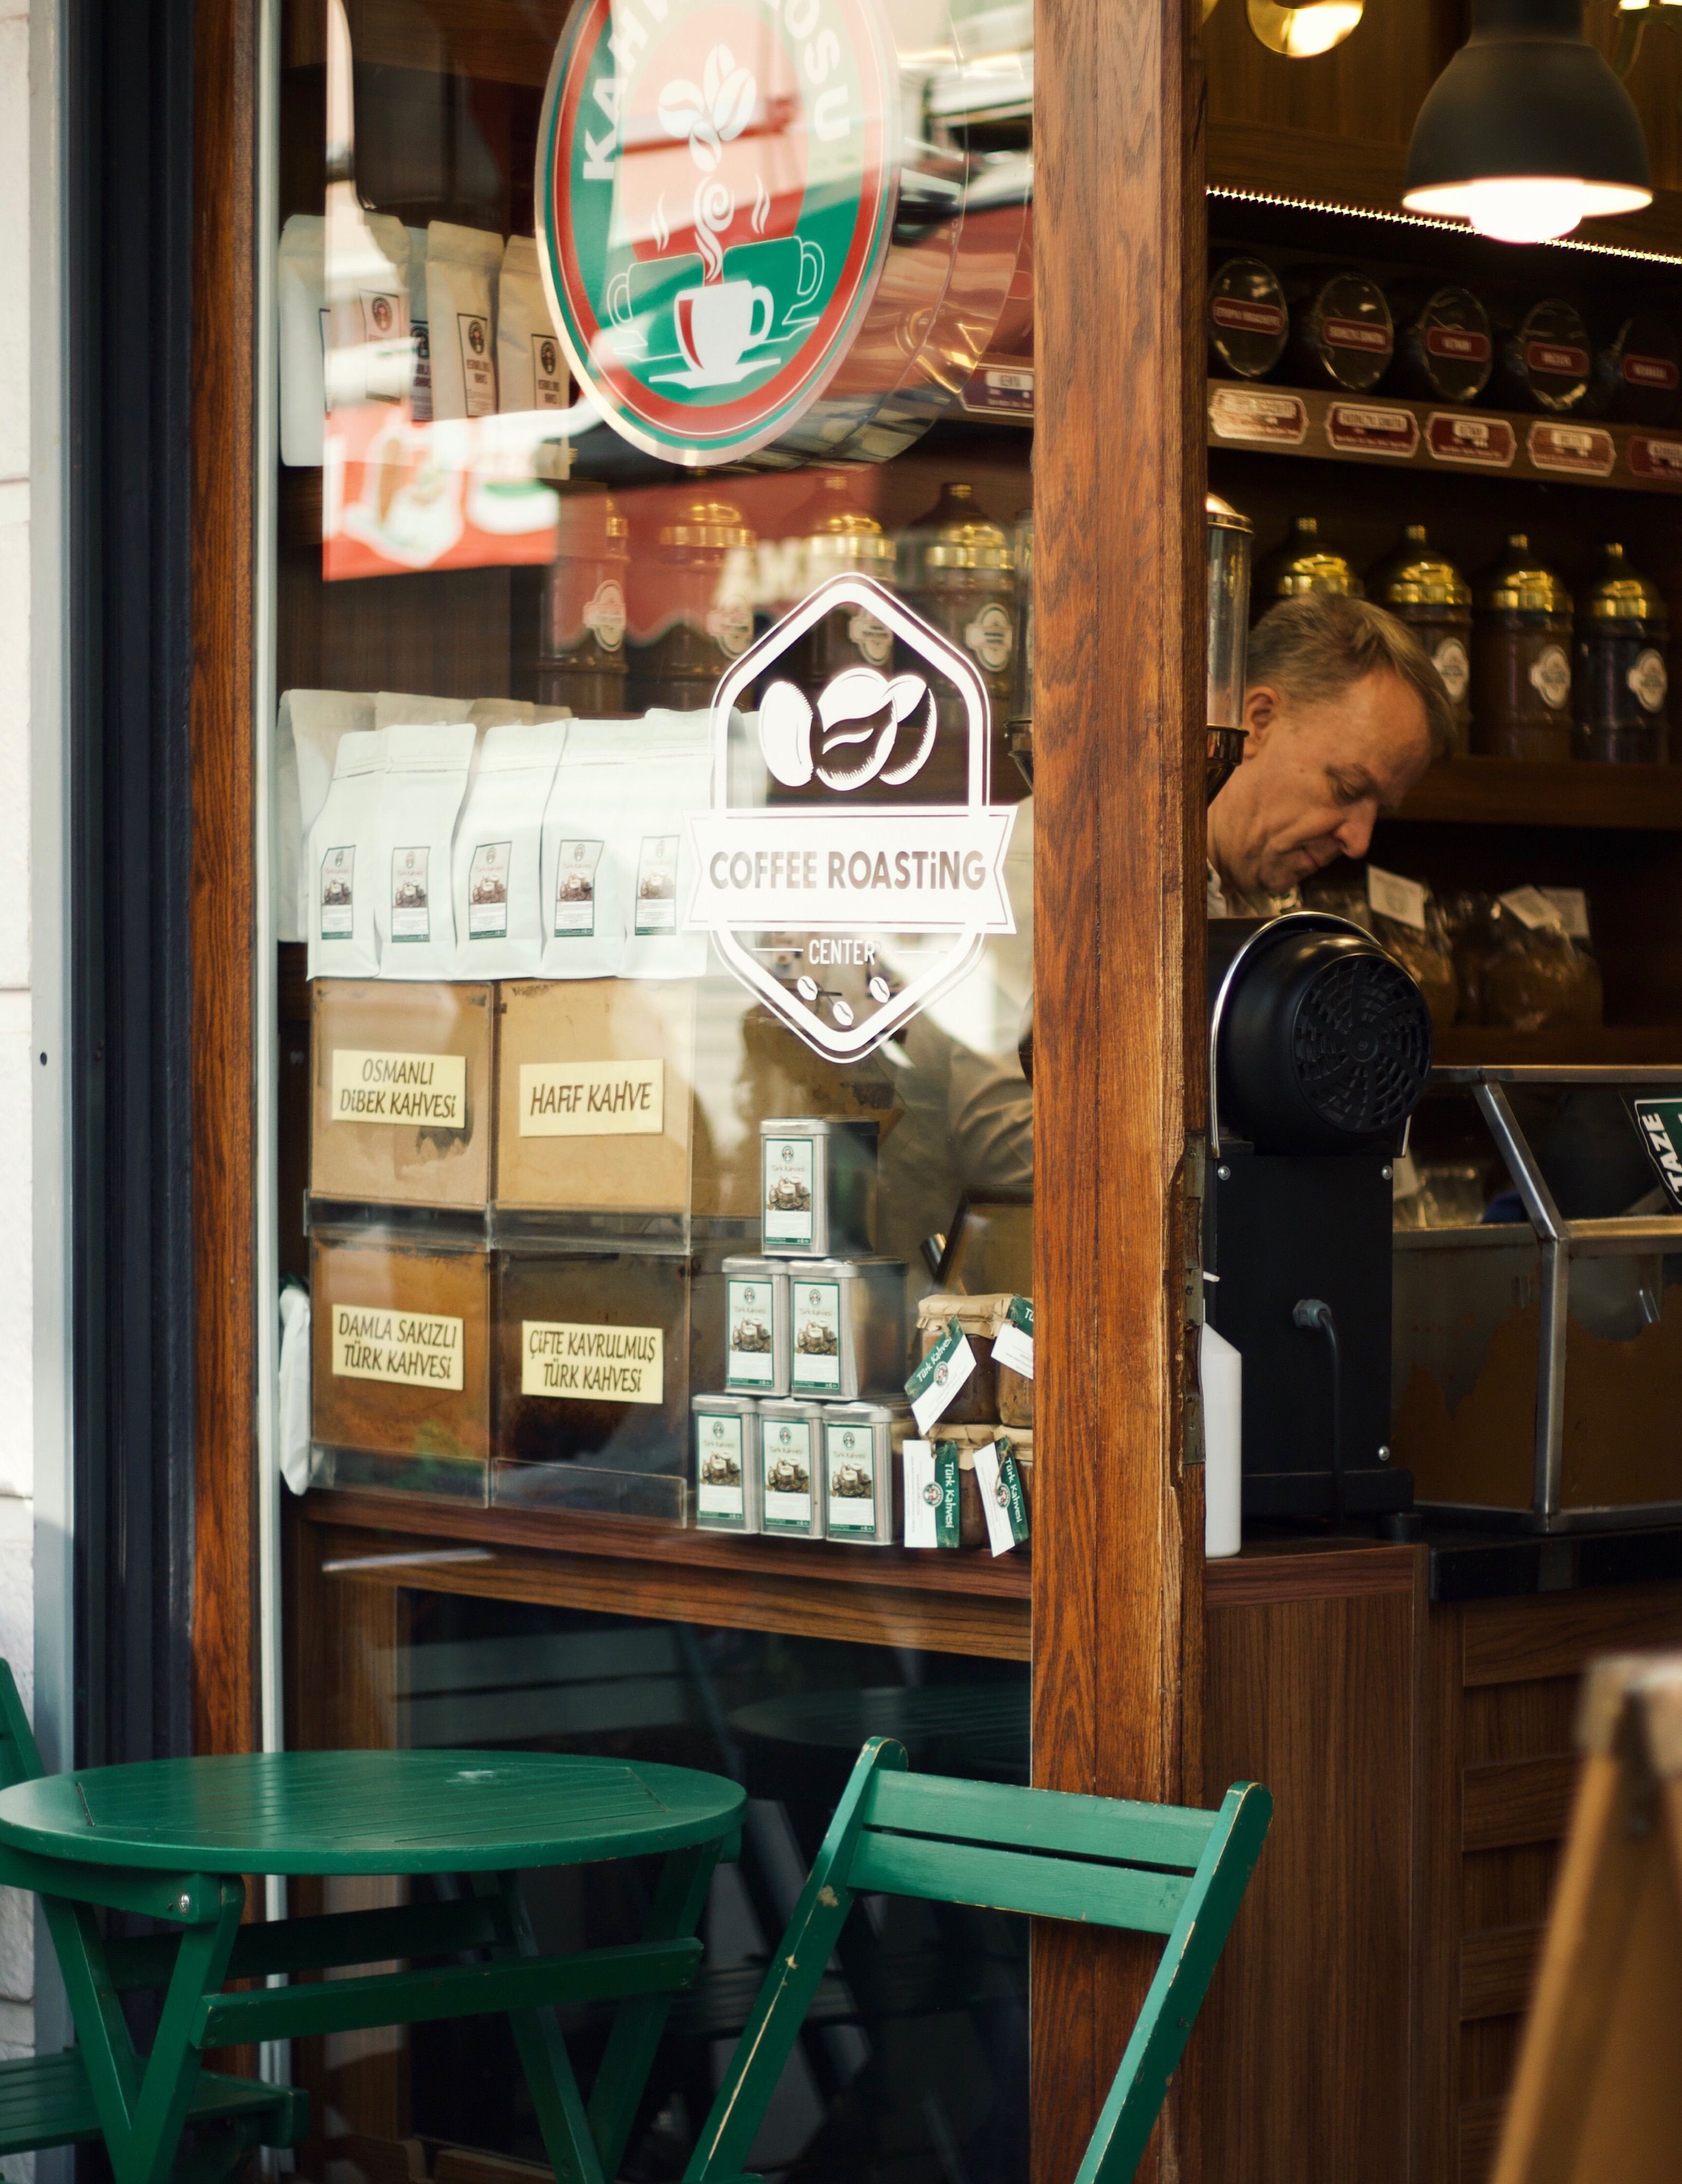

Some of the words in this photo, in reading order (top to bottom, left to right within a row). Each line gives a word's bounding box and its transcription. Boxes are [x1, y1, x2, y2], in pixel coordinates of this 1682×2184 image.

[709, 851, 818, 889] COFFEE
[808, 939, 876, 966] CENTER
[362, 1059, 434, 1085] OSMANLI
[587, 1080, 653, 1114] KAHVE
[339, 1313, 392, 1341] DAMLA
[396, 1319, 457, 1349] SAKIZLI
[344, 1340, 383, 1370] TÜRK
[567, 1332, 656, 1363] KAVRULMUŞ
[544, 1357, 579, 1388] TÜRK
[944, 1462, 954, 1487] Türk
[1004, 1457, 1015, 1482] Türk
[1010, 1484, 1023, 1523] Kahvesi
[945, 1489, 956, 1528] Kahvesi
